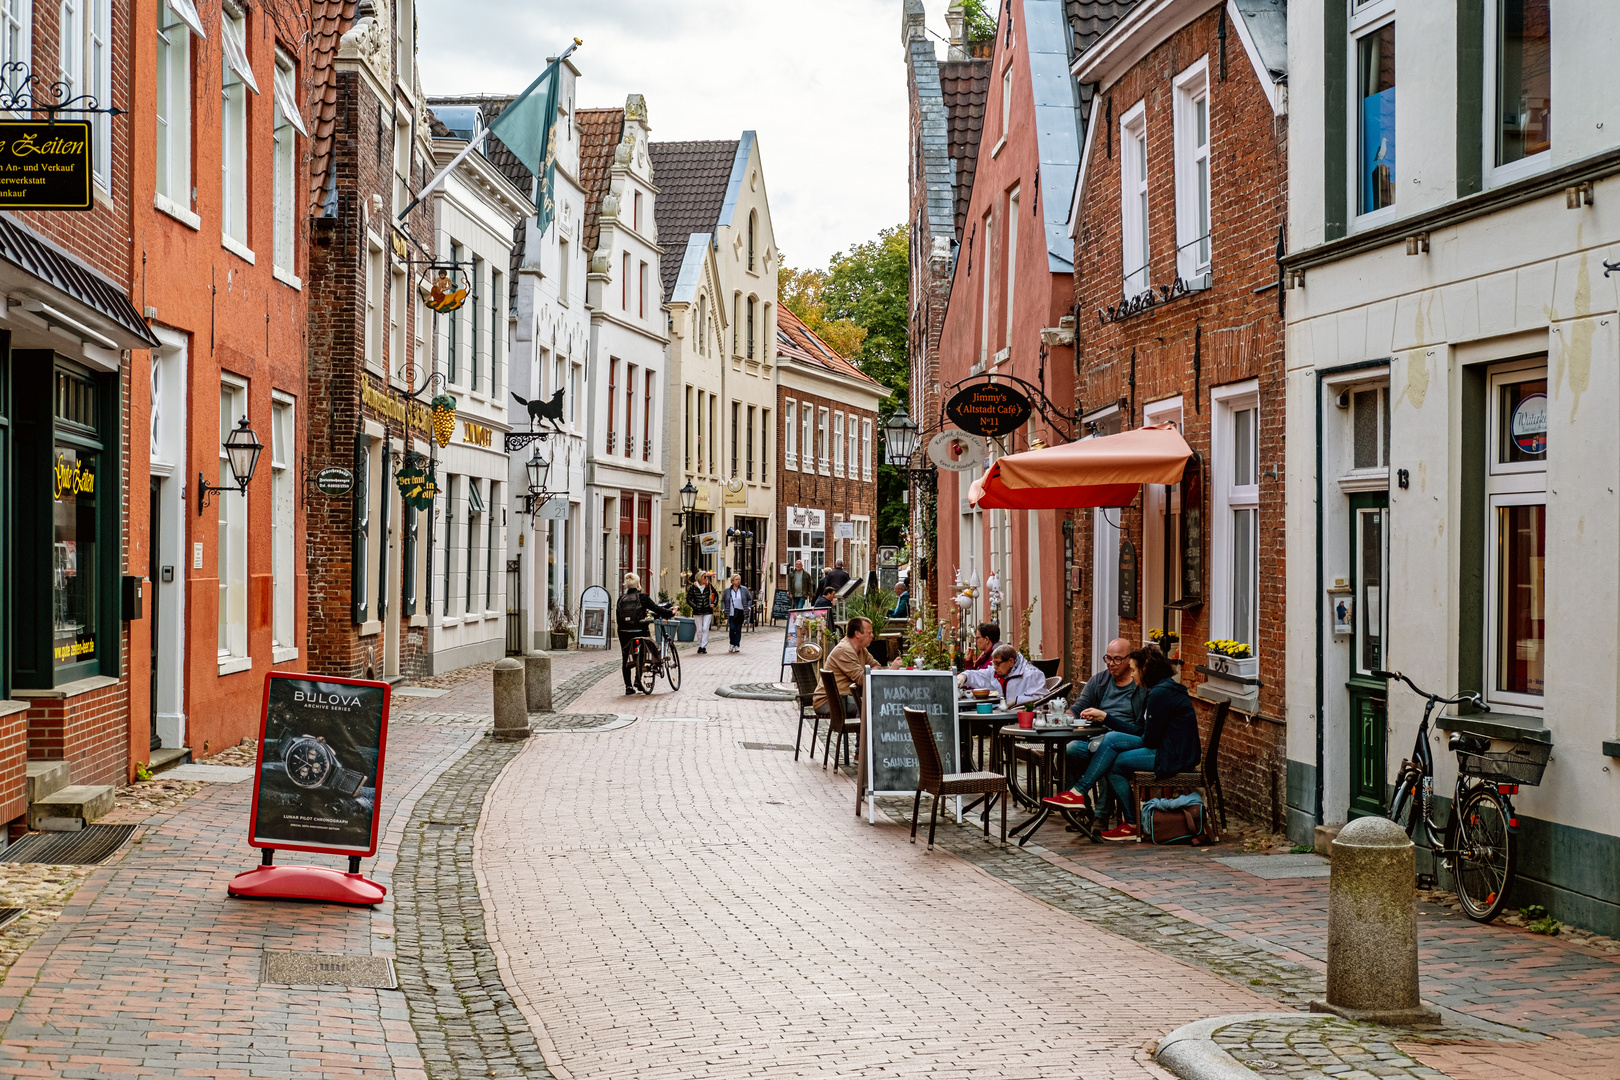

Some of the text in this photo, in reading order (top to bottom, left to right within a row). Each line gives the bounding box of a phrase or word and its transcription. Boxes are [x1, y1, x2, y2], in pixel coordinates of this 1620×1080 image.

[11, 132, 85, 157] Zeiten
[5, 163, 22, 172] An-
[23, 163, 39, 172] und
[41, 163, 75, 172] Verkauf
[972, 392, 1007, 404] Jimmy's
[963, 404, 1017, 414] Altstadt Café
[72, 458, 95, 495] Zeiten
[1396, 468, 1410, 490] 13
[554, 507, 567, 518] 21
[294, 690, 362, 707] BULOVA
[883, 685, 931, 700] WARMER
[903, 743, 913, 755] &
